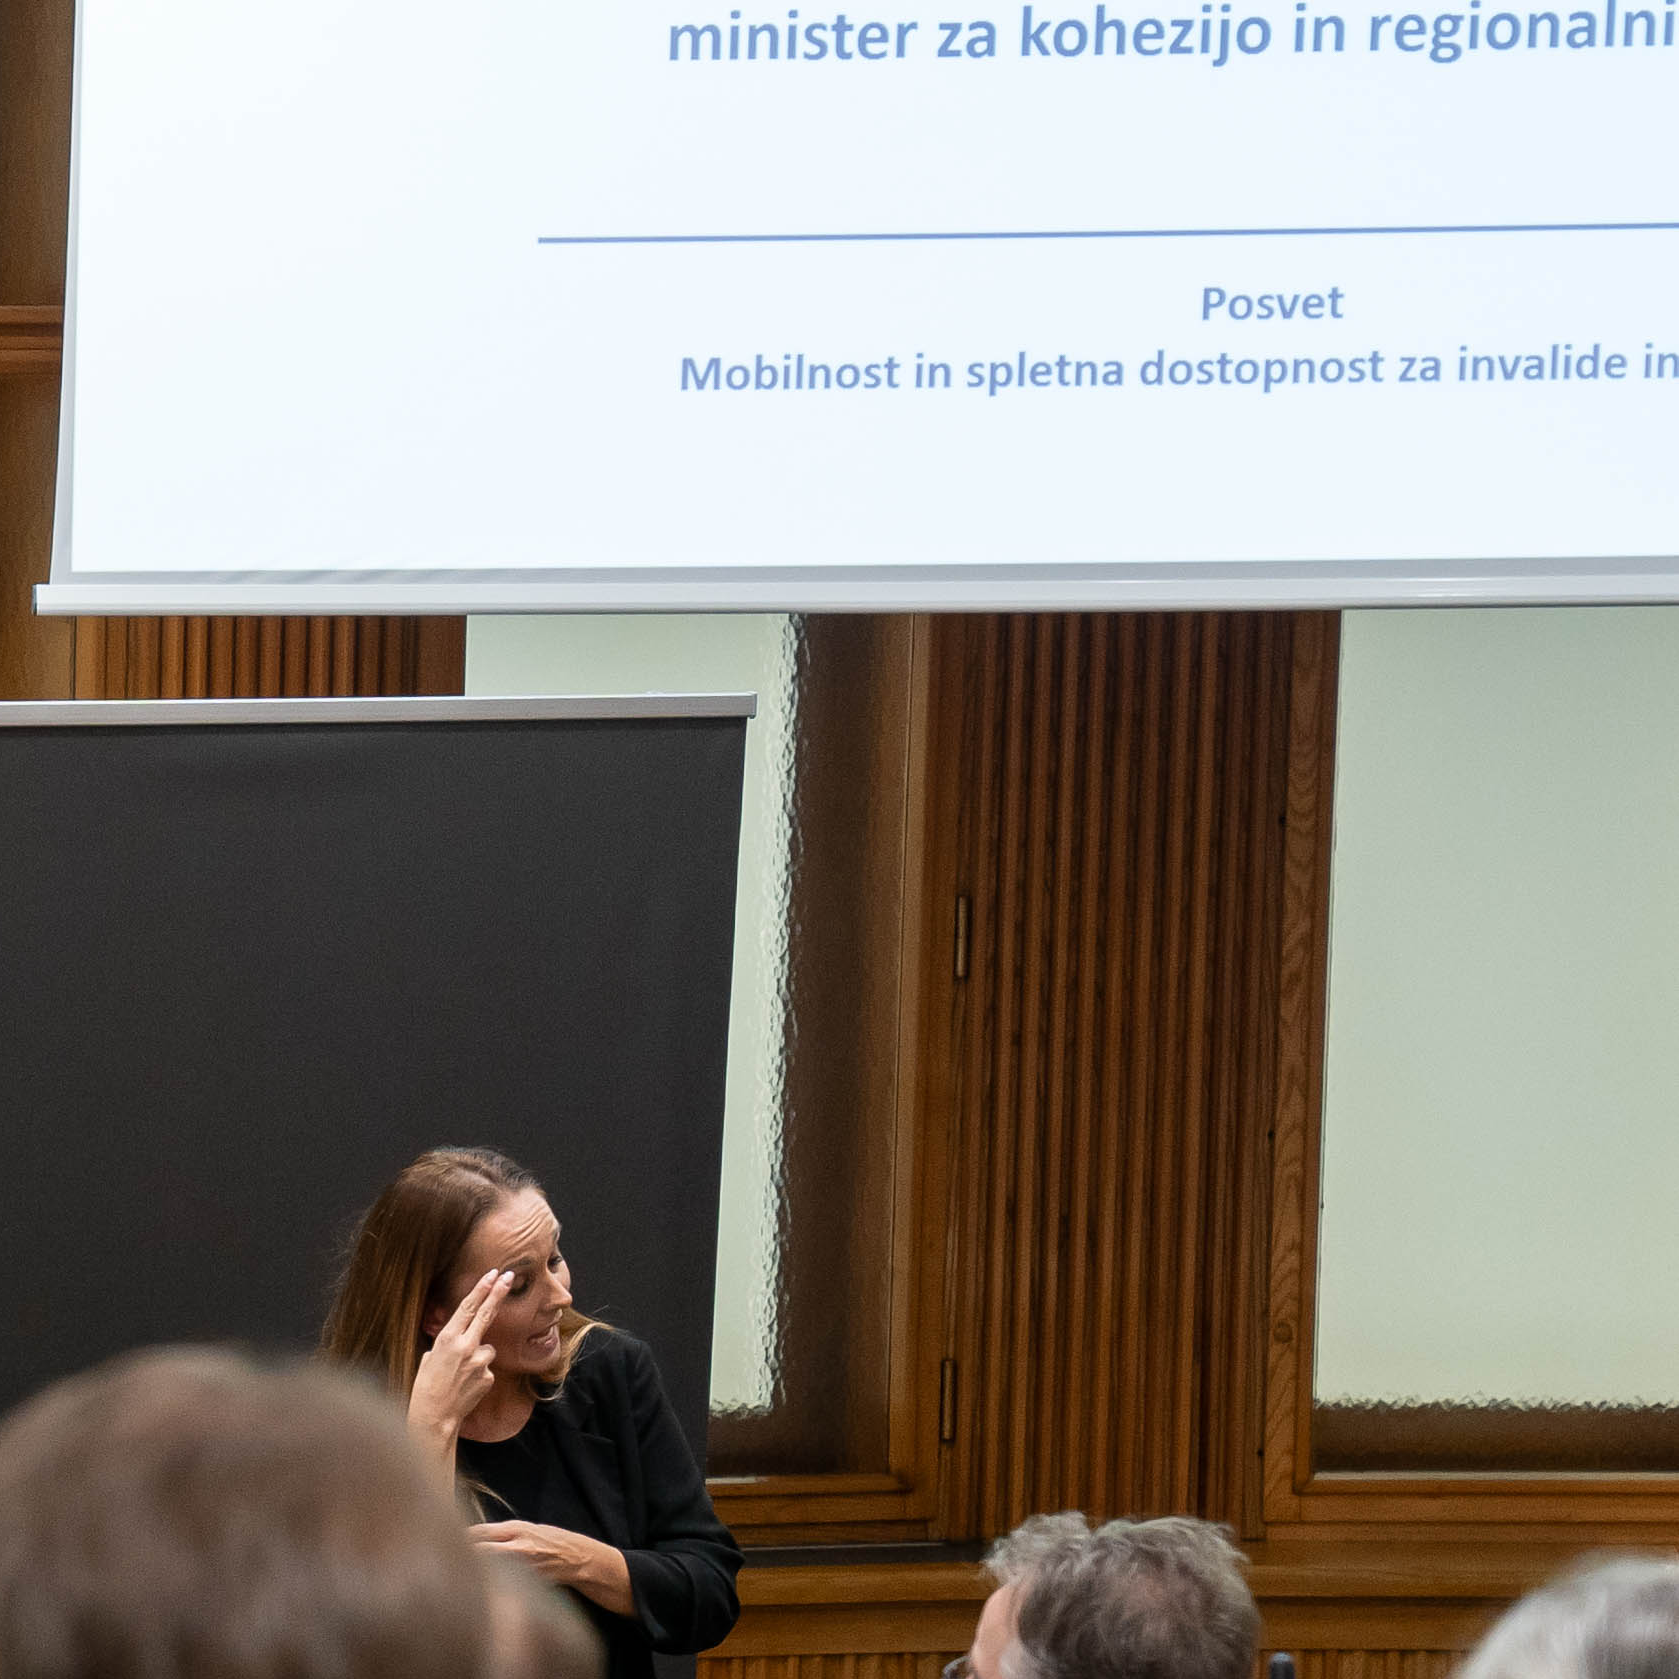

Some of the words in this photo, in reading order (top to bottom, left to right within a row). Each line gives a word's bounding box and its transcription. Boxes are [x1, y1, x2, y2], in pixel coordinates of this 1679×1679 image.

[669, 9, 919, 61] minister
[937, 20, 997, 59] za
[1020, 3, 1272, 68] kohezijo
[1293, 2, 1346, 53] in
[1369, 0, 1677, 65] regionalni
[1201, 286, 1345, 321] Posvet
[680, 353, 901, 392] Mobilnost
[914, 352, 952, 389] in
[966, 351, 1125, 398] spletna
[1139, 348, 1385, 395] dostopnost
[1398, 356, 1442, 383] za
[1458, 343, 1628, 382] invalide
[1643, 341, 1679, 379] in
